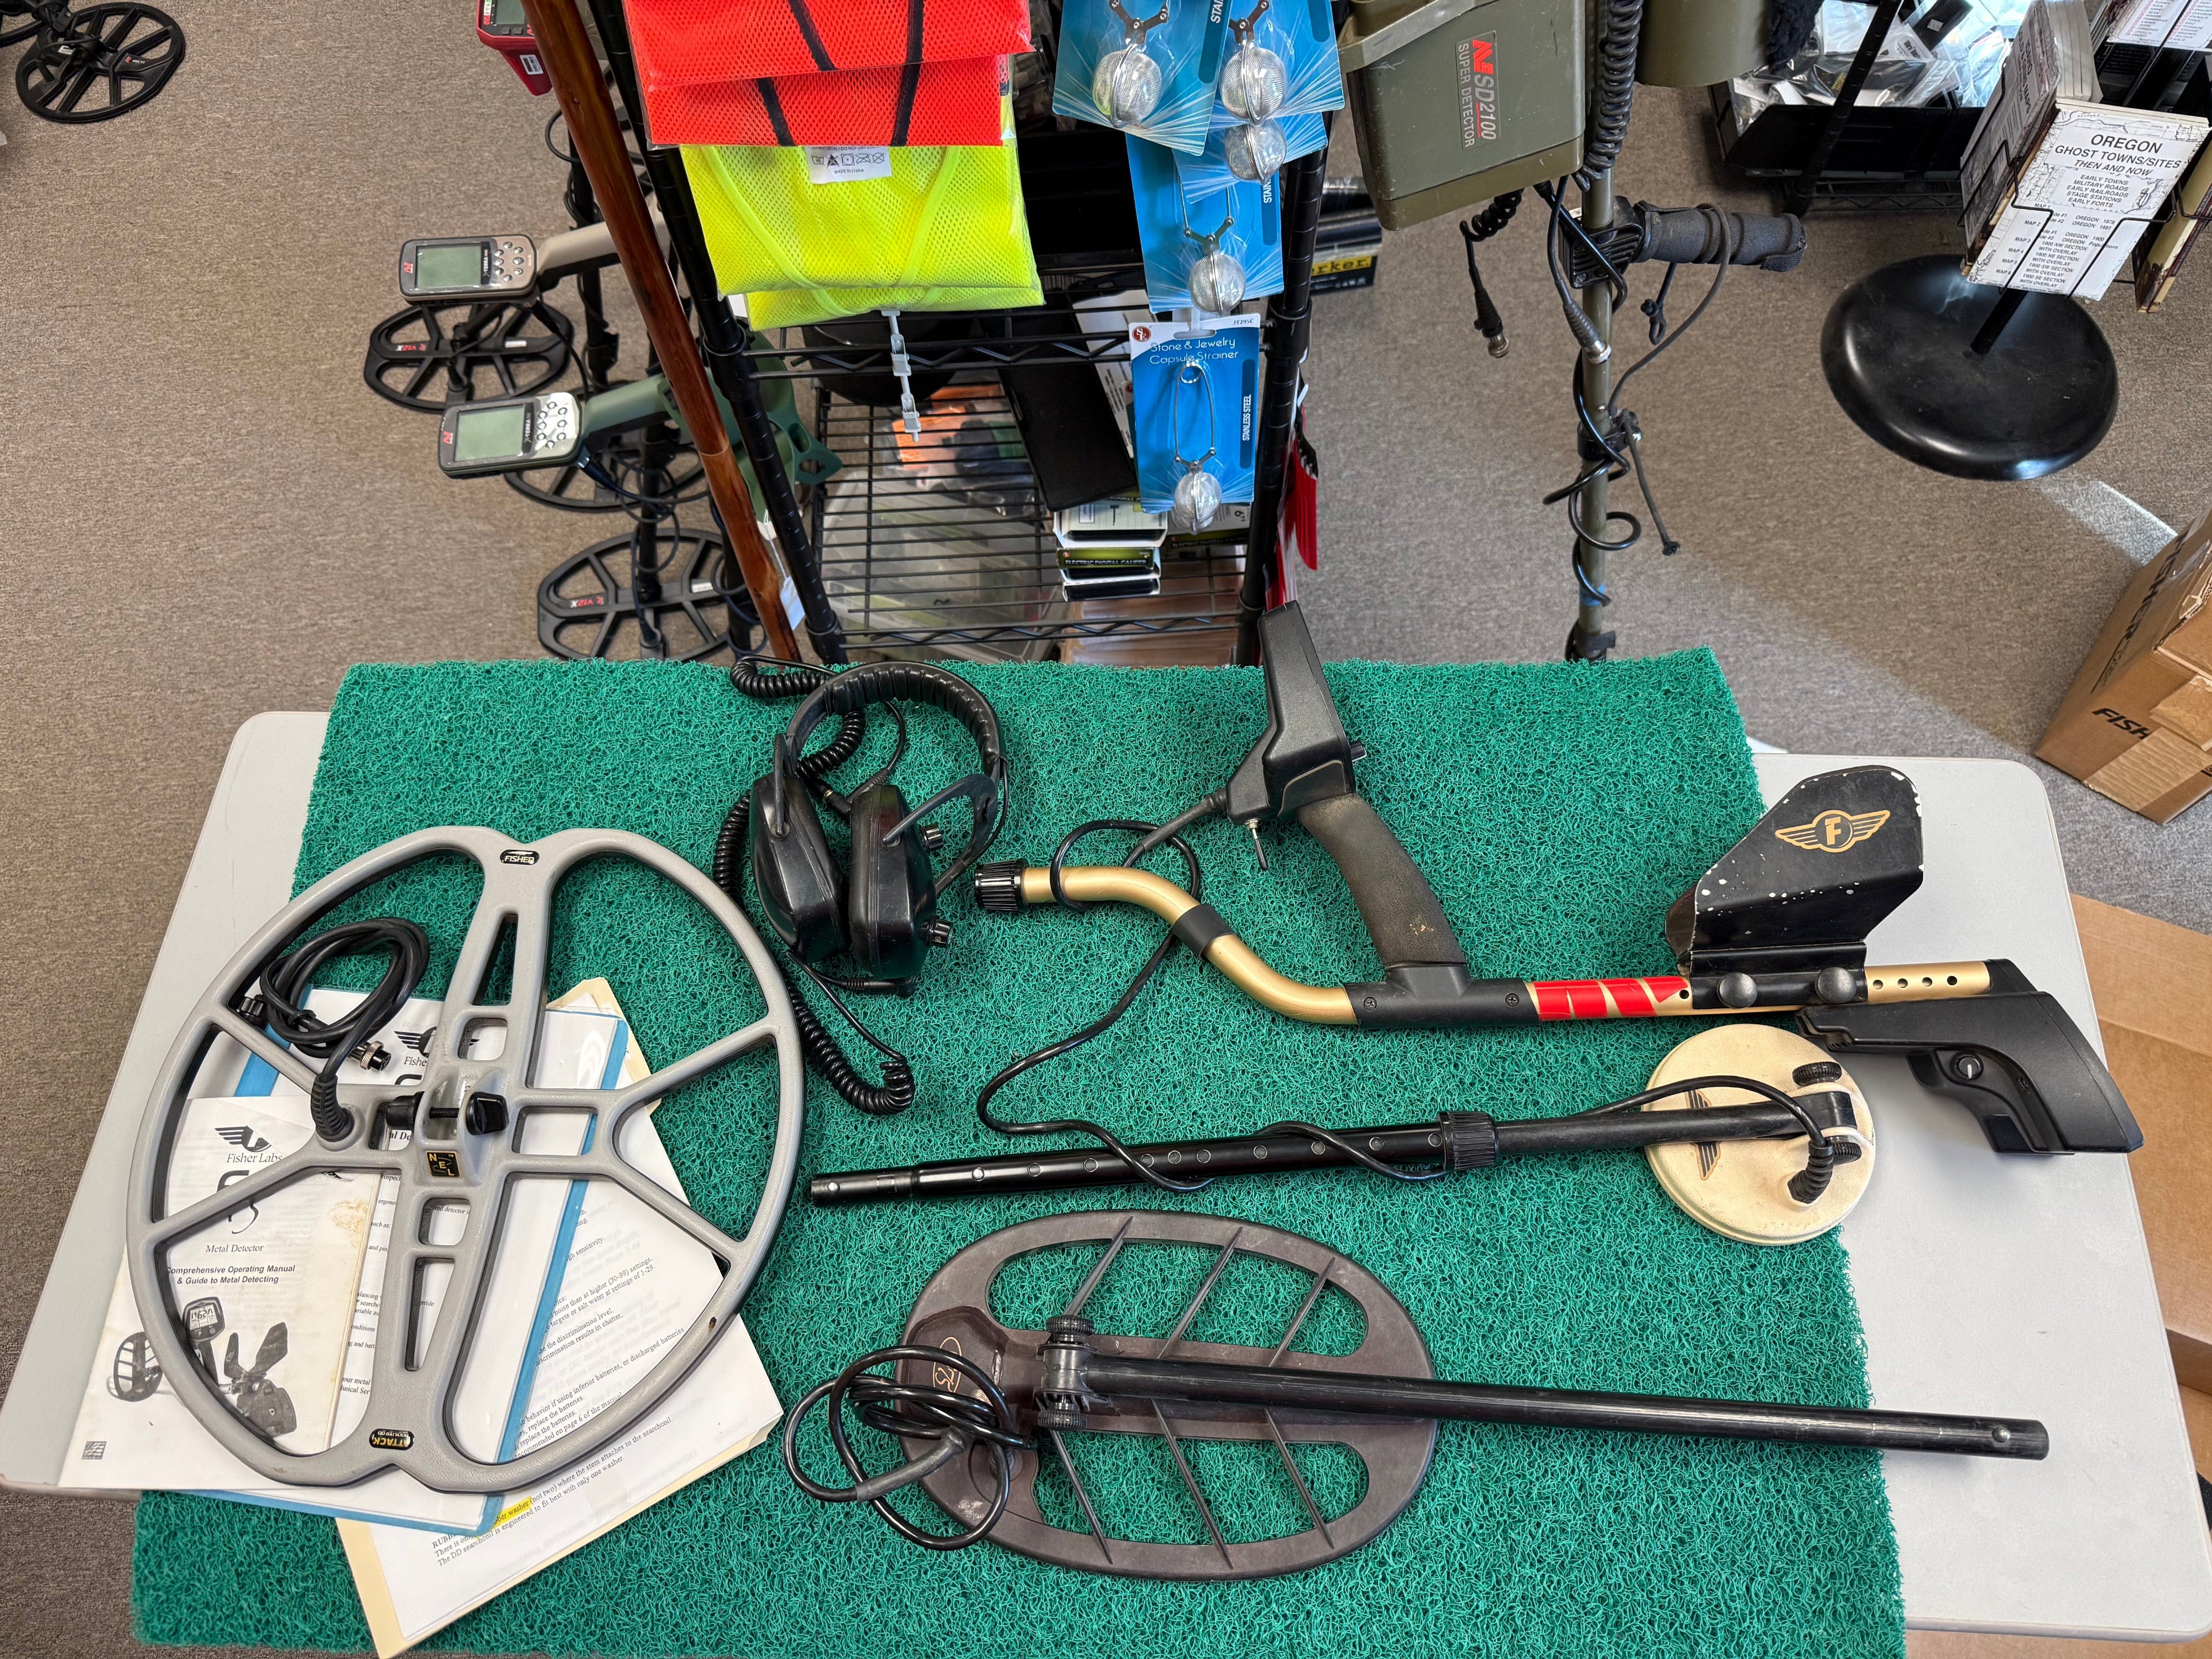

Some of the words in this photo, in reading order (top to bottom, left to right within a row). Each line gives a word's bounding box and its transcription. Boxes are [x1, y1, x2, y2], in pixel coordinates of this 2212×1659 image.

[1459, 43, 1471, 84] SUPER
[1474, 74, 1496, 140] SD2100
[1462, 87, 1475, 147] DETECTOR
[2091, 134, 2163, 154] OREGON
[2055, 145, 2099, 159] GHOST
[2100, 151, 2182, 169] TOWNS/SITES
[2074, 159, 2103, 170] THEN
[2103, 164, 2125, 173] AND
[2127, 167, 2154, 176] NOW
[2073, 180, 2104, 189] MILITARY
[2105, 183, 2129, 192] ROADS
[2105, 177, 2128, 186] TOWNS
[1263, 178, 1272, 204] STAIN
[2066, 191, 2089, 199] STAGE
[2089, 194, 2122, 203] STATIONS
[2089, 188, 2129, 198] RAILROADS
[2068, 197, 2091, 206] EARLY
[2091, 200, 2114, 208] FORTS
[2062, 237, 2086, 246] OREGON
[2065, 231, 2089, 240] OREGON
[2053, 248, 2078, 256] OVERLAY
[2064, 243, 2088, 252] SECTION
[2046, 258, 2072, 267] OVERLAY
[2039, 269, 2065, 278] OVERLAY
[2033, 280, 2058, 289] OVERLAY
[1150, 342, 1181, 352] Stone
[1185, 341, 1192, 349] &
[1196, 337, 1236, 349] Jewelry
[1150, 352, 1194, 366] Capsule
[1197, 351, 1239, 361] Strainer
[1243, 394, 1251, 413] STEEL
[1242, 413, 1251, 441] STAINLESS
[504, 855, 535, 863] FISHER
[226, 1153, 258, 1163] Fisher
[206, 1244, 229, 1253] Metal
[231, 1244, 264, 1253] Detector
[228, 1265, 264, 1275] Operating
[267, 1264, 295, 1272] Manual
[242, 1275, 279, 1284] Detecting
[554, 1304, 570, 1316] noise
[570, 1297, 582, 1306] than
[589, 1282, 607, 1295] higher
[608, 1269, 629, 1285] (30-99)
[630, 1258, 653, 1272] settings.
[550, 1313, 570, 1327] targets
[578, 1302, 588, 1312] salt
[588, 1293, 604, 1304] water
[612, 1277, 633, 1292] settings
[634, 1271, 640, 1280] of
[557, 1317, 597, 1343] discrimination
[575, 1329, 594, 1343] results
[524, 1405, 550, 1422] behavior
[557, 1392, 573, 1404] using
[573, 1379, 594, 1394] inferior
[594, 1364, 623, 1381] batteries,
[630, 1340, 660, 1361] discharged
[528, 1417, 549, 1431] replace
[549, 1411, 559, 1419] the
[564, 1420, 578, 1432] page
[583, 1410, 590, 1418] of
[591, 1406, 601, 1416] the
[520, 1432, 541, 1447] replace
[550, 1411, 577, 1428] batteries.
[435, 1545, 453, 1557] There
[508, 1501, 529, 1515] washer
[530, 1493, 542, 1505] (not
[542, 1484, 557, 1496] two)
[557, 1474, 576, 1487] where
[576, 1468, 586, 1477] the
[586, 1459, 600, 1470] stem
[601, 1445, 624, 1462] attaches
[643, 1417, 673, 1437] searchcoil.
[437, 1557, 450, 1566] The
[450, 1549, 462, 1559] DD
[463, 1530, 494, 1552] searchcoil
[502, 1508, 534, 1530] engineered
[549, 1493, 562, 1503] best
[562, 1484, 576, 1495] with
[577, 1476, 589, 1487] only
[591, 1469, 602, 1478] one
